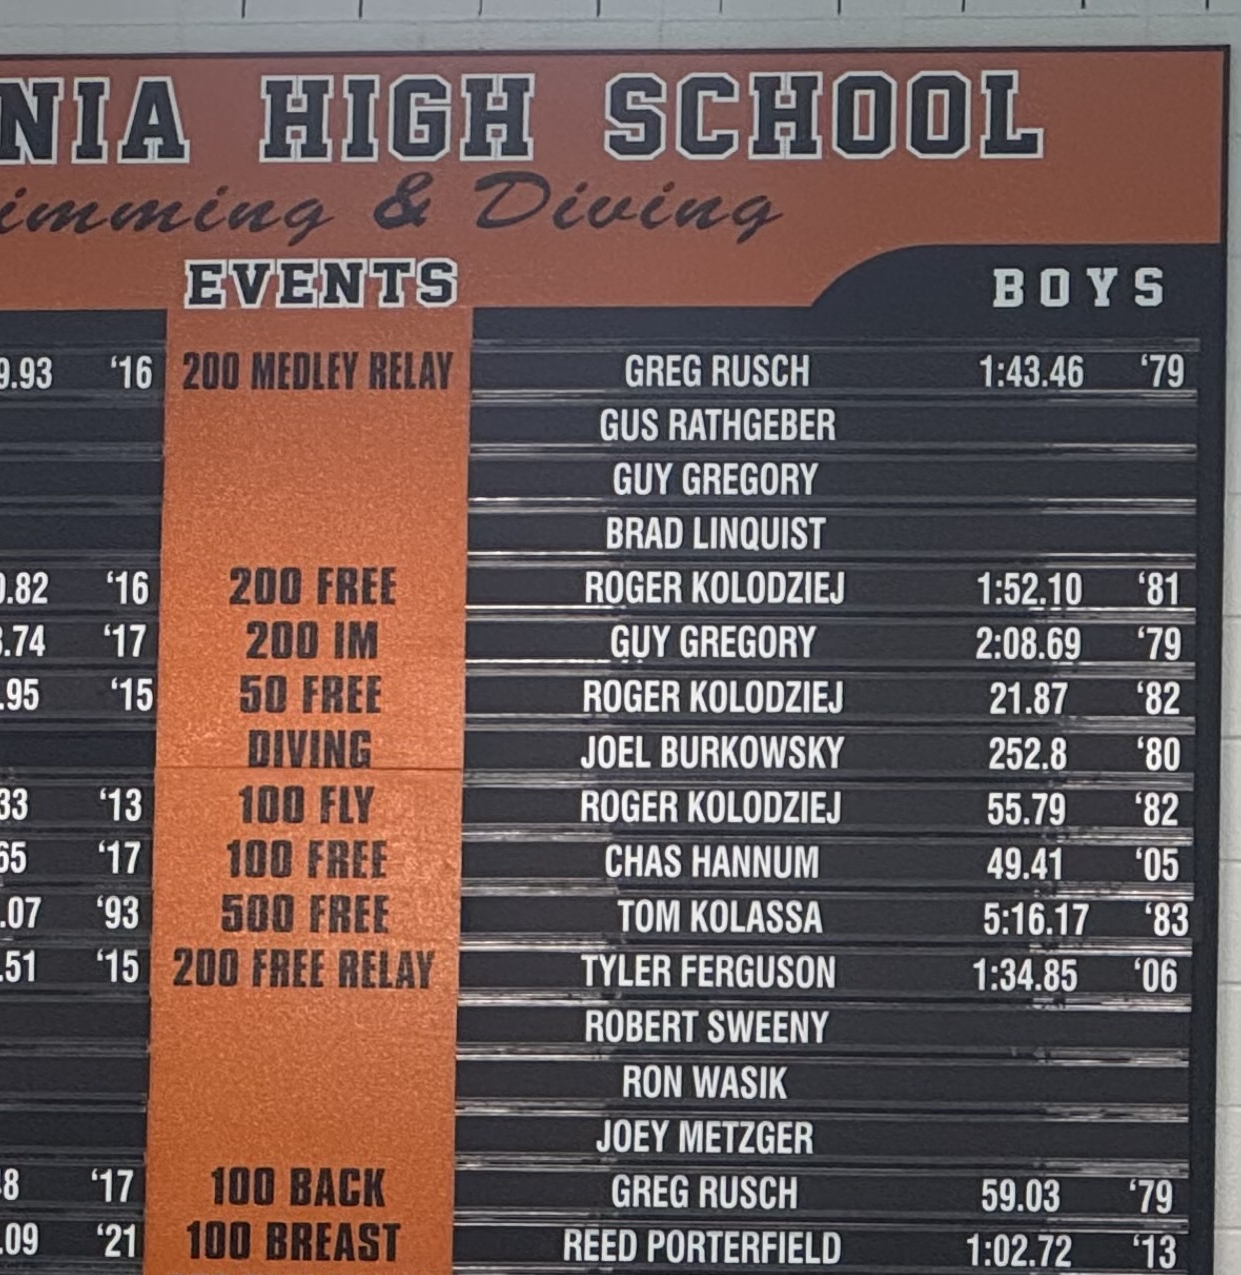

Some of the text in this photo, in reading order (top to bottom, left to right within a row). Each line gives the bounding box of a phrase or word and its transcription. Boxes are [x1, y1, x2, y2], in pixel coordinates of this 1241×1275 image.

[258, 72, 534, 163] HIGH
[604, 69, 1044, 161] SCHOOL
[374, 170, 433, 230] &
[475, 170, 783, 245] Diving
[183, 257, 458, 311] EVENTS
[993, 267, 1163, 308] BOYS
[182, 351, 454, 391] 200 MEDLEY RELAY
[625, 354, 702, 388] GREG
[711, 354, 810, 388] RUSCH
[980, 354, 1084, 388] 1:43.46
[229, 566, 397, 605] 200 FREE
[585, 570, 683, 604] ROGER
[691, 570, 845, 605] KOLODZIEJ
[977, 571, 1082, 606] 1:52.10
[246, 620, 378, 660] 200 IM
[240, 675, 382, 714] 50 FREE
[583, 679, 681, 713] ROGER
[689, 679, 843, 714] KOLODZIEJ
[989, 681, 1068, 715] 21.87
[247, 729, 371, 769] DIVING
[580, 734, 652, 770] JOEL
[660, 734, 845, 770] BURKOWSKY
[988, 736, 1067, 771] 252.8
[238, 785, 375, 824] 100 FLY
[580, 789, 679, 823] ROGER
[687, 789, 842, 825] KOLODZIEJ
[987, 792, 1066, 826] 55.79
[226, 839, 387, 879] 100 FREE
[605, 843, 682, 878] CHAS
[692, 844, 819, 879] HANNUM
[986, 846, 1062, 881] 49.41
[221, 893, 389, 934] 500 FREE
[983, 901, 1090, 936] 5:16.17
[172, 947, 435, 990] 200 FREE RELAY
[580, 953, 671, 987] TYLER
[681, 954, 836, 989] FERGUSON
[972, 957, 1078, 992] 1:34.85
[210, 1166, 386, 1208] 100 BACK
[611, 1174, 689, 1209] GREG
[699, 1175, 798, 1210] RUSCH
[981, 1178, 1060, 1213] 59.03
[186, 1220, 402, 1263] 100 BREAST
[563, 1228, 637, 1262] REED
[647, 1229, 841, 1265] PORTERFIELD
[966, 1233, 1072, 1268] 1:02.72
